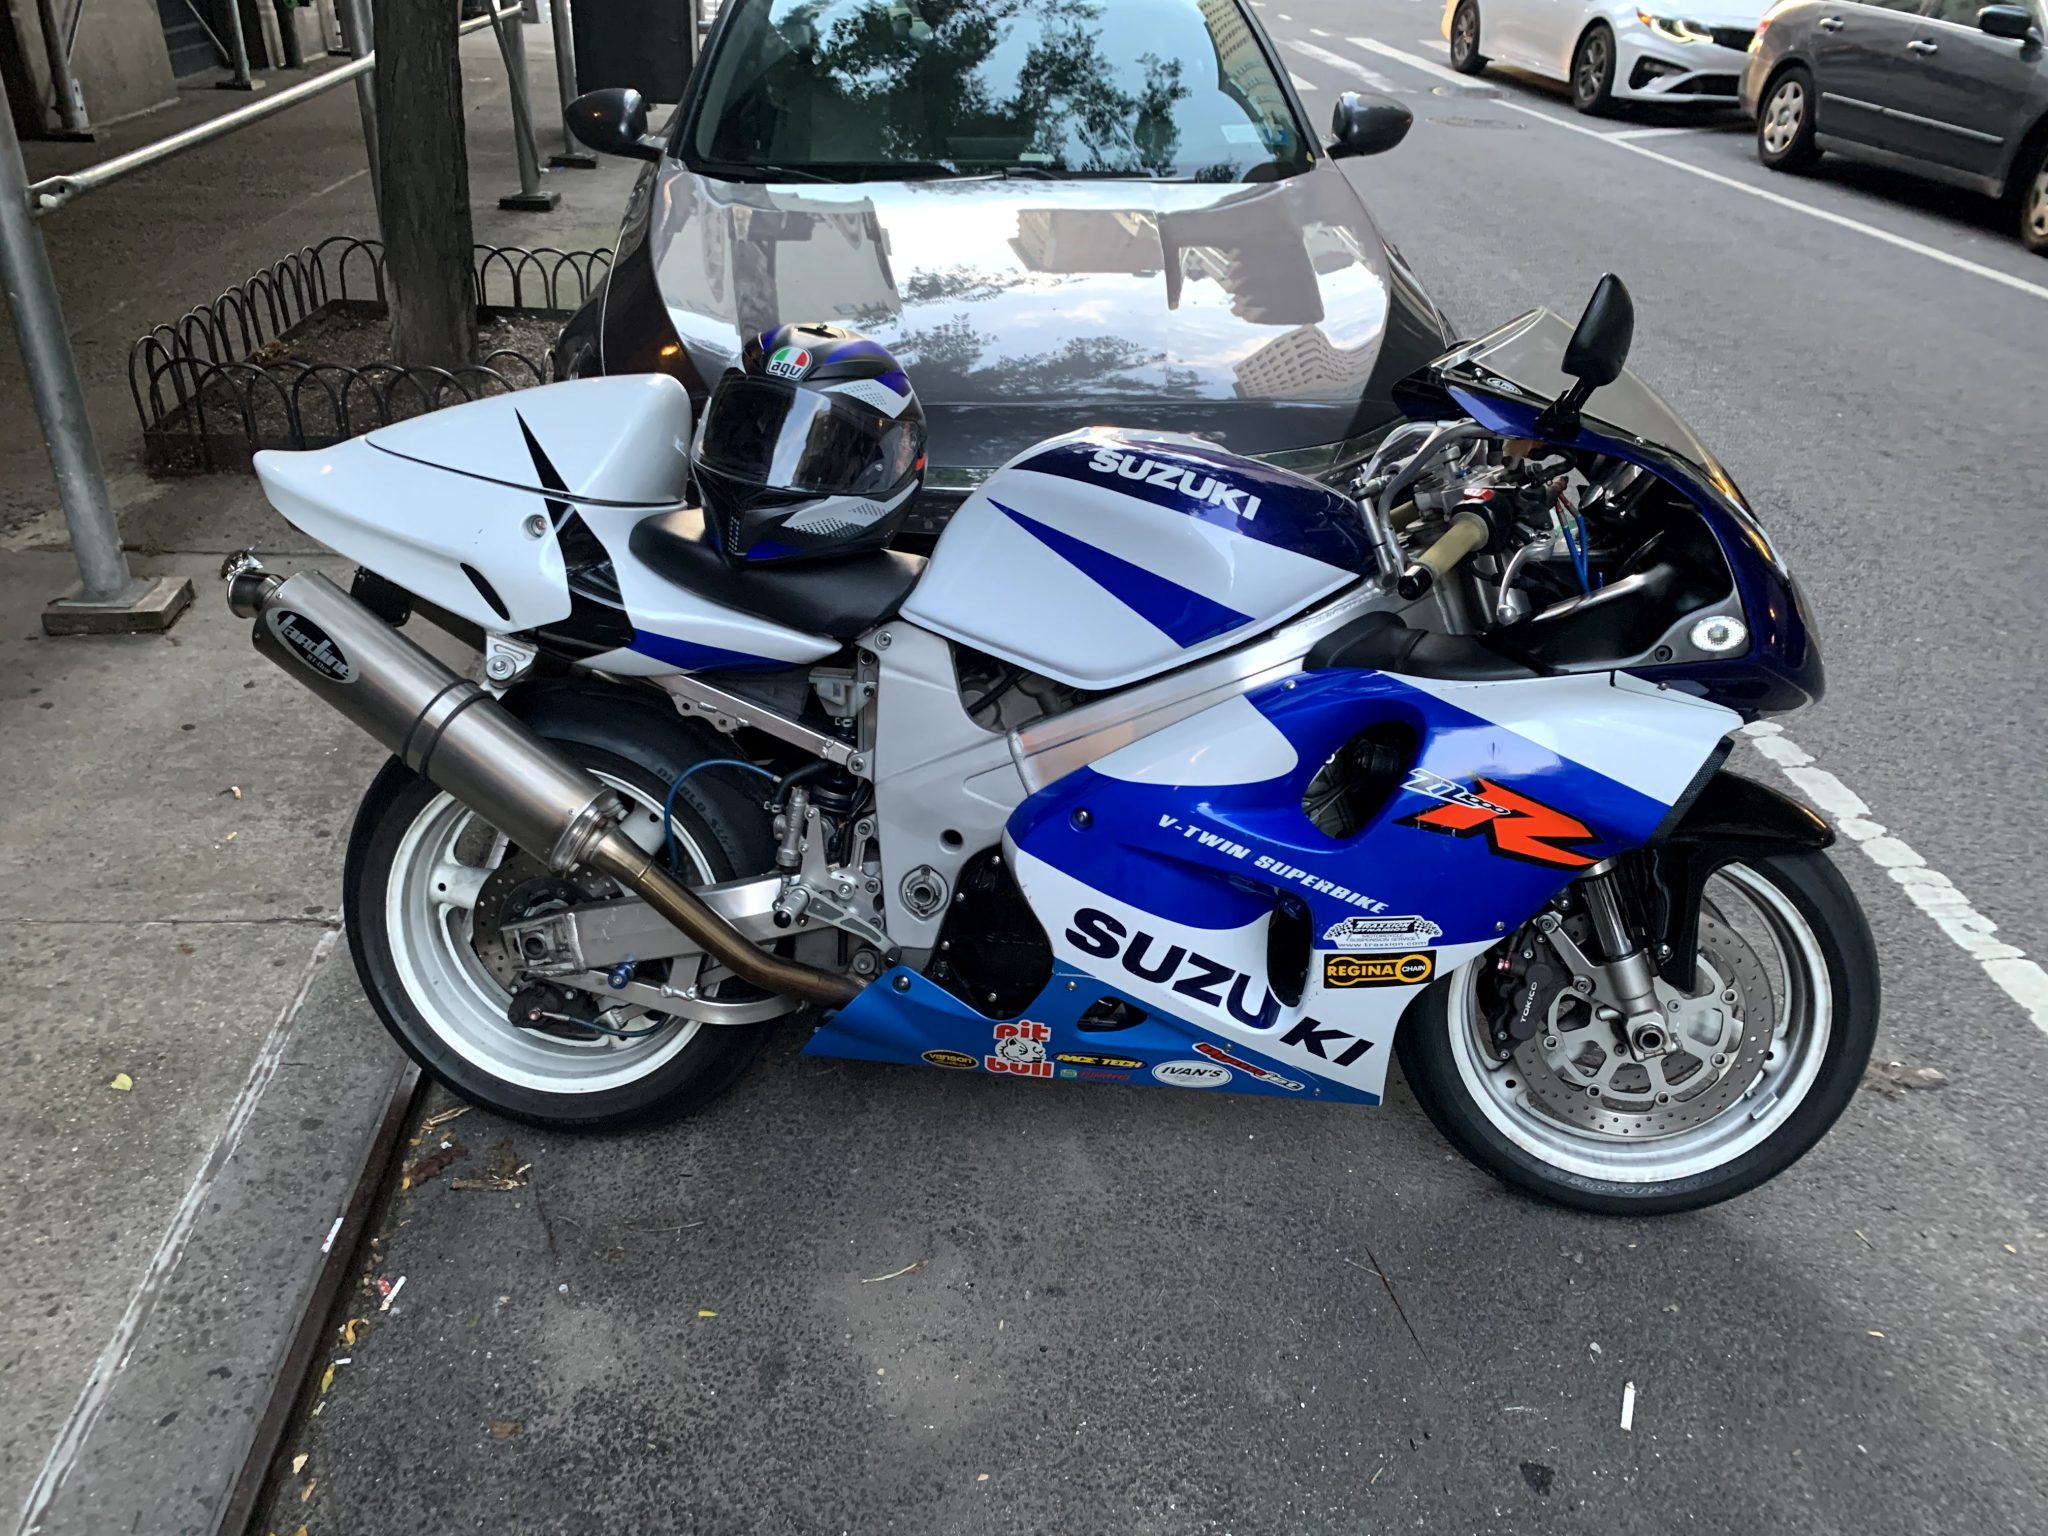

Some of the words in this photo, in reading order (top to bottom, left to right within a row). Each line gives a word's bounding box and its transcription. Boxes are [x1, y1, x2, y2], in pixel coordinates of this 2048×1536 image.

[770, 360, 803, 377] agv
[1088, 450, 1262, 521] SUZUKI
[1158, 814, 1251, 860] V-TWIN
[1253, 855, 1389, 914] SUPERBIKE
[1327, 964, 1394, 976] REGINA
[1401, 965, 1426, 973] CHAIN
[1065, 907, 1375, 1067] SUZUKI
[1520, 981, 1538, 1023] TOKICO
[996, 1021, 1049, 1041] pit
[986, 1057, 1052, 1077] bull
[1056, 1054, 1099, 1064] RACE
[1101, 1058, 1143, 1068] TECH
[1161, 1066, 1223, 1078] IVAN'S
